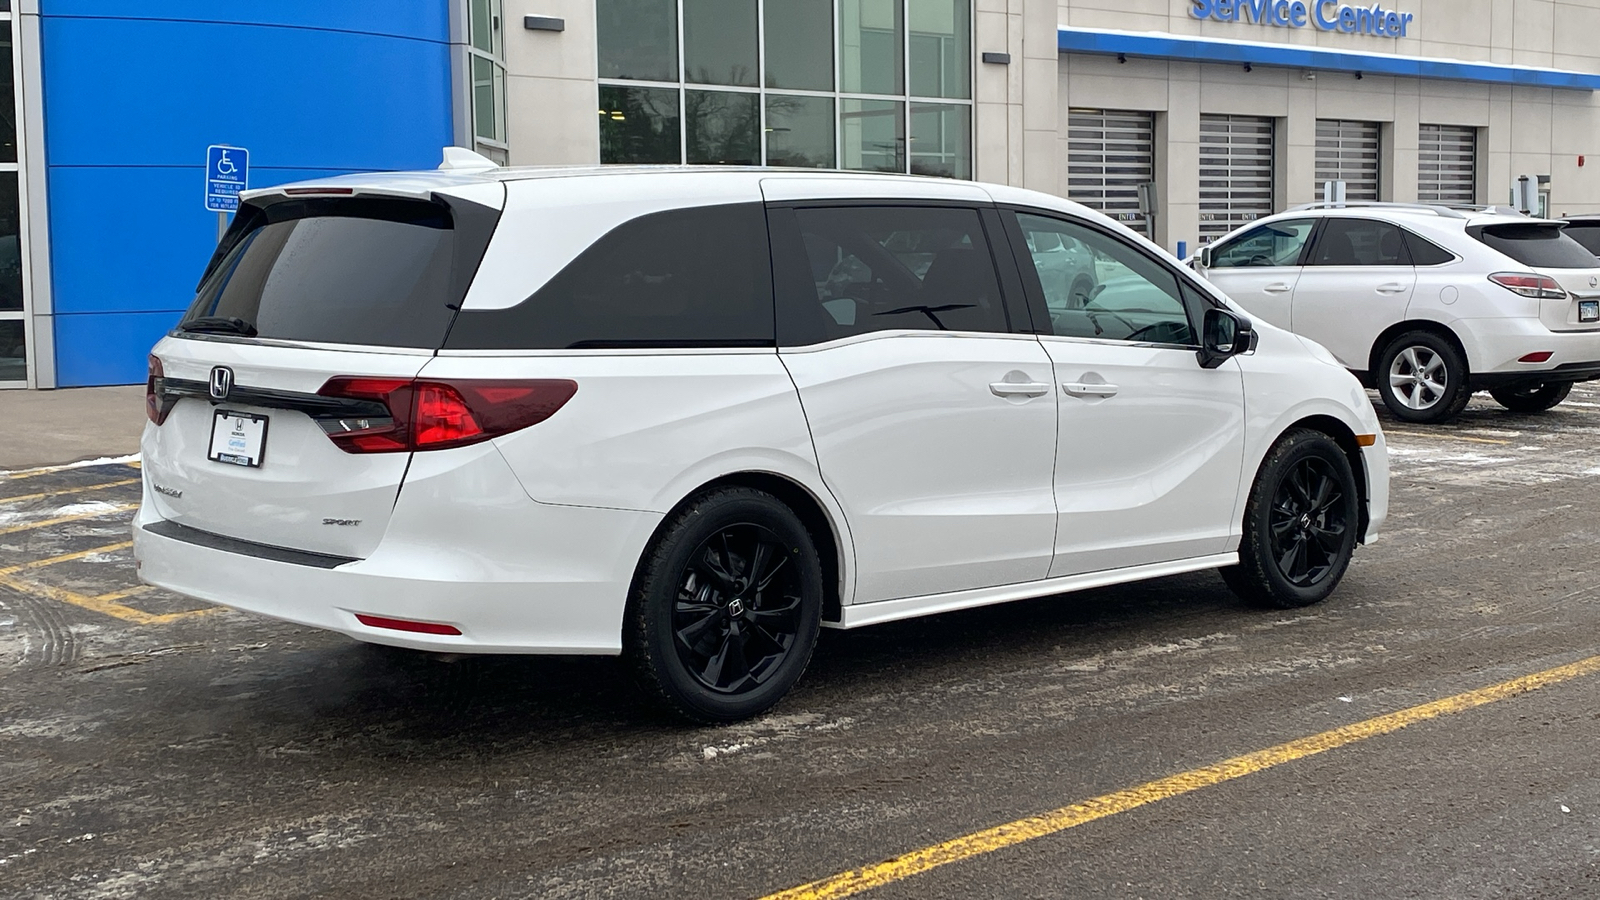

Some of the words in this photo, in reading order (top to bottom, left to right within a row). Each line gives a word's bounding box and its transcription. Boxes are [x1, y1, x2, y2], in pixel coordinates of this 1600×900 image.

[1189, 0, 1307, 27] Service
[1312, 0, 1413, 38] Center
[322, 518, 362, 526] SPORT
